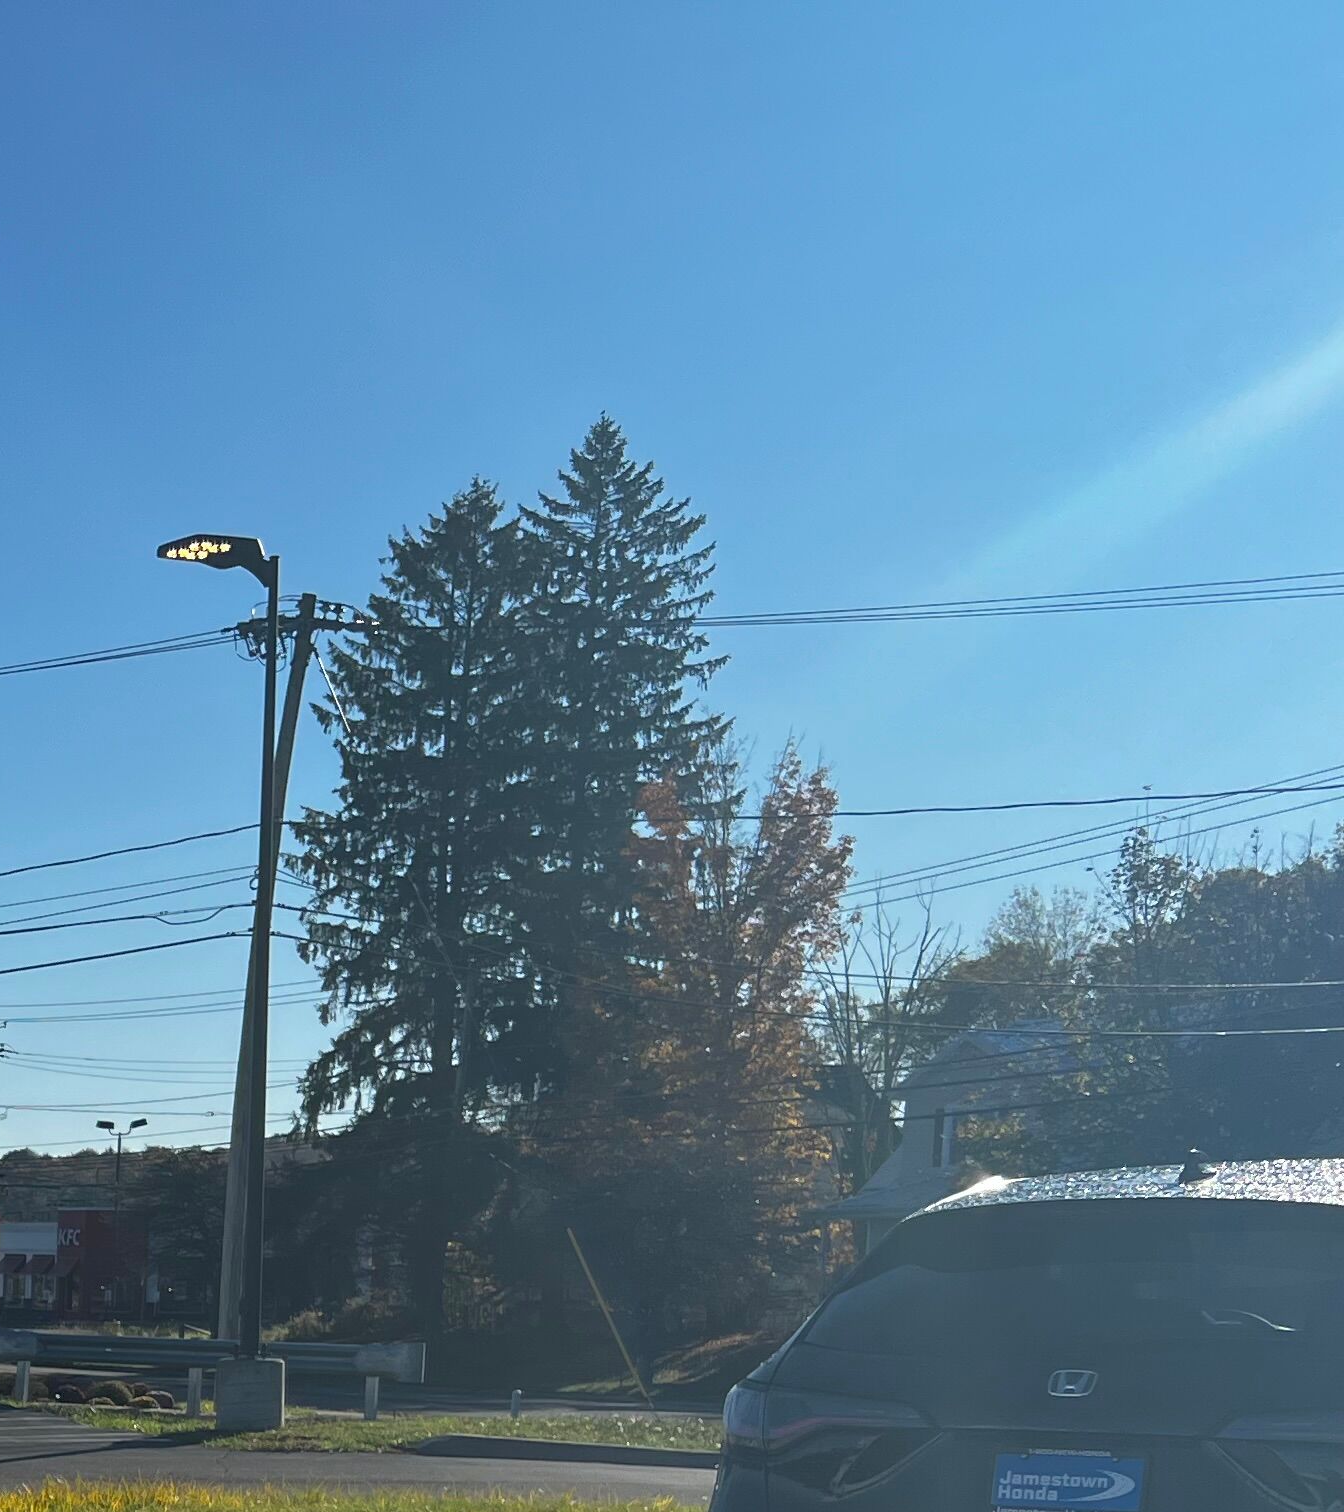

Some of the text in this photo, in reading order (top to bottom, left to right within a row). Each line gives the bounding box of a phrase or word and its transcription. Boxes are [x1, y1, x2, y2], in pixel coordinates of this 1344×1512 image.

[58, 1229, 80, 1246] KFC
[999, 1470, 1109, 1489] Jamestown
[997, 1485, 1058, 1501] Honda
